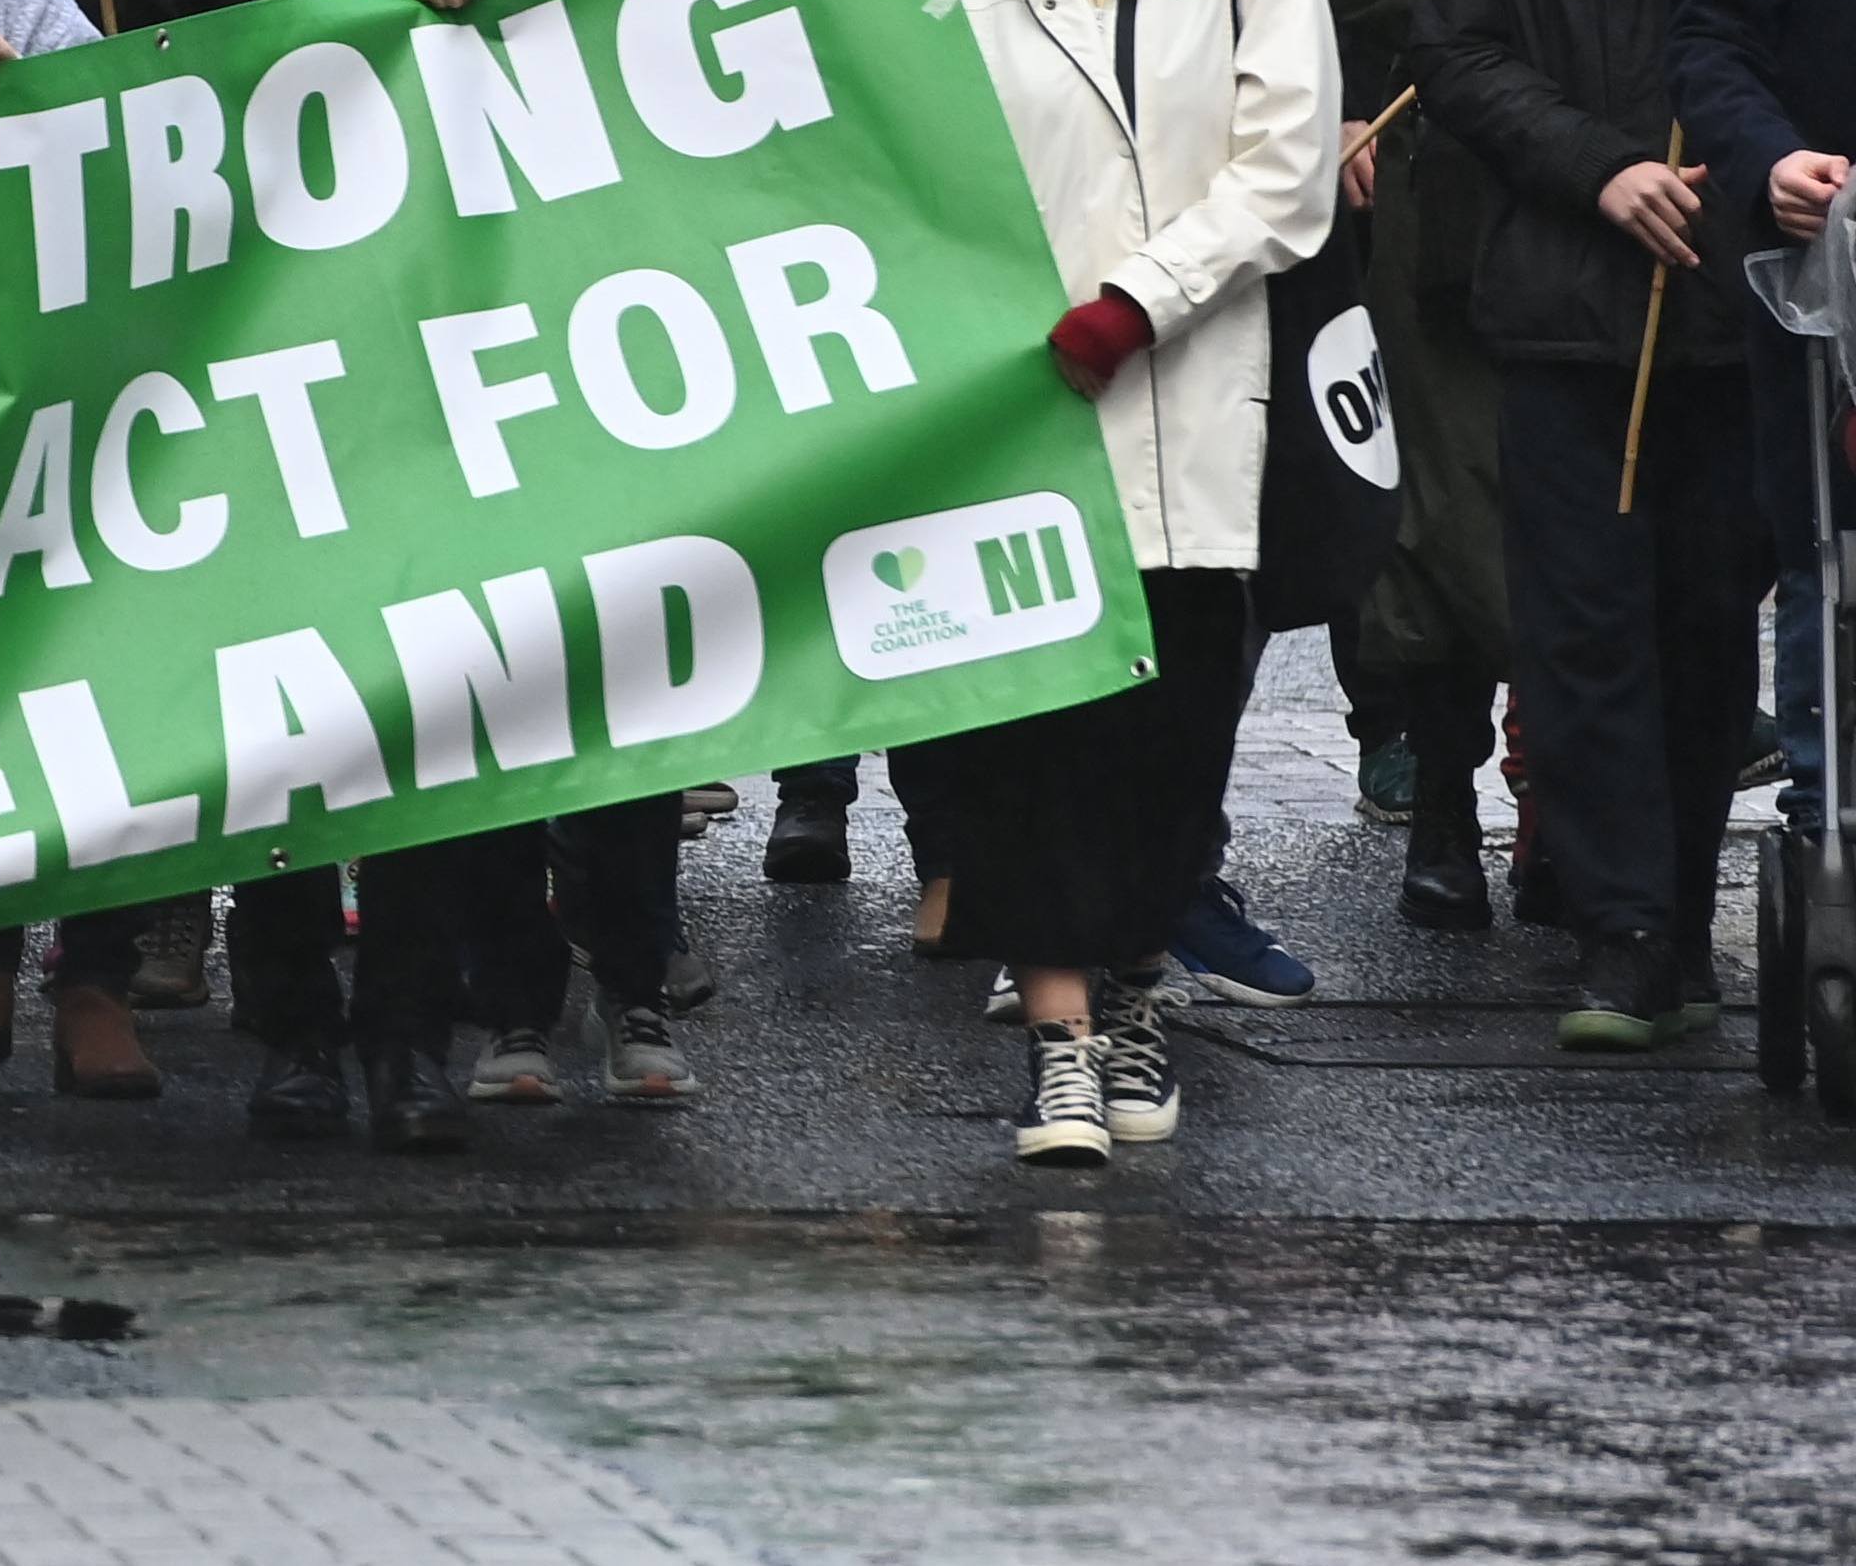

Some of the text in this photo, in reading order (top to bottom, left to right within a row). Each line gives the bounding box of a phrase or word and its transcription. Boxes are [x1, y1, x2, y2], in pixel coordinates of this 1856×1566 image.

[418, 223, 918, 500] FOR
[974, 524, 1078, 617] NI
[889, 598, 928, 614] THE
[869, 621, 969, 654] COALITION
[874, 610, 953, 638] CLIMATE
